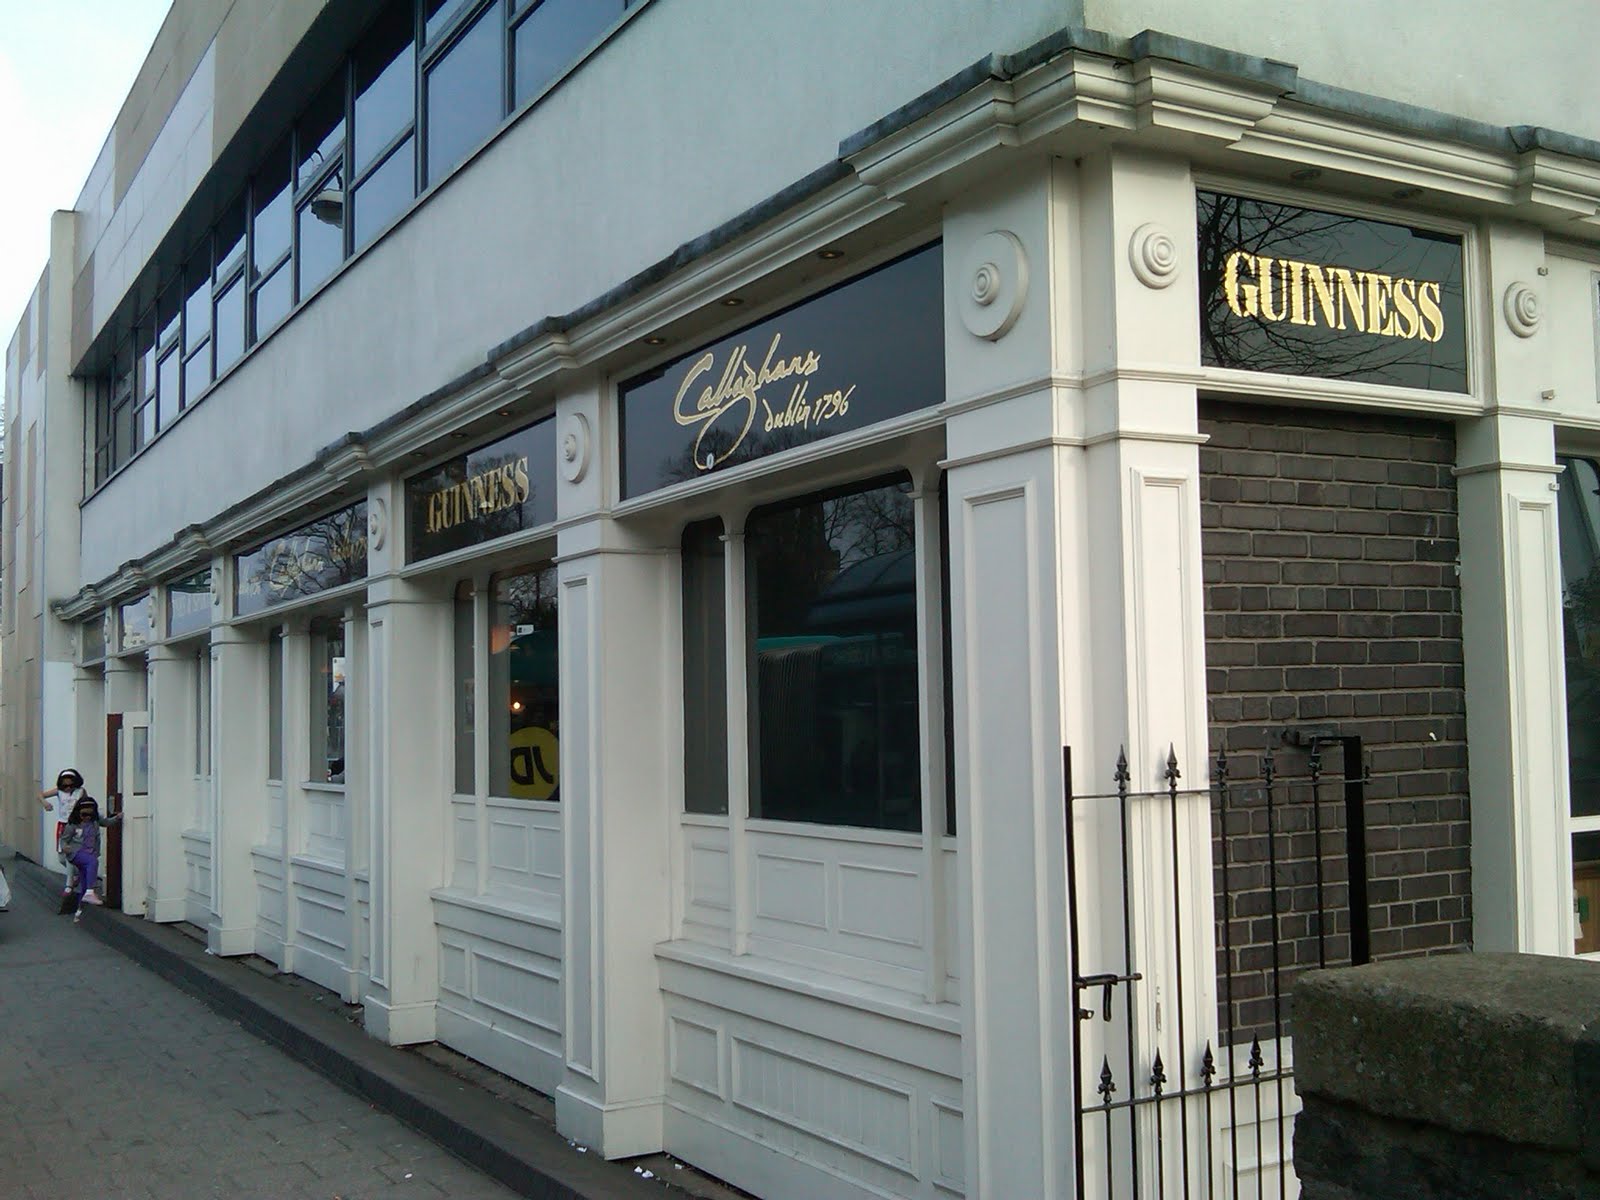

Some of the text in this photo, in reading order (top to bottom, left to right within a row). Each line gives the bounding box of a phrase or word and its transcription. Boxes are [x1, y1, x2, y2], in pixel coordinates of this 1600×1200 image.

[1224, 251, 1445, 343] GUINNESS
[812, 384, 857, 425] 1796
[426, 456, 530, 533] GUINNESS
